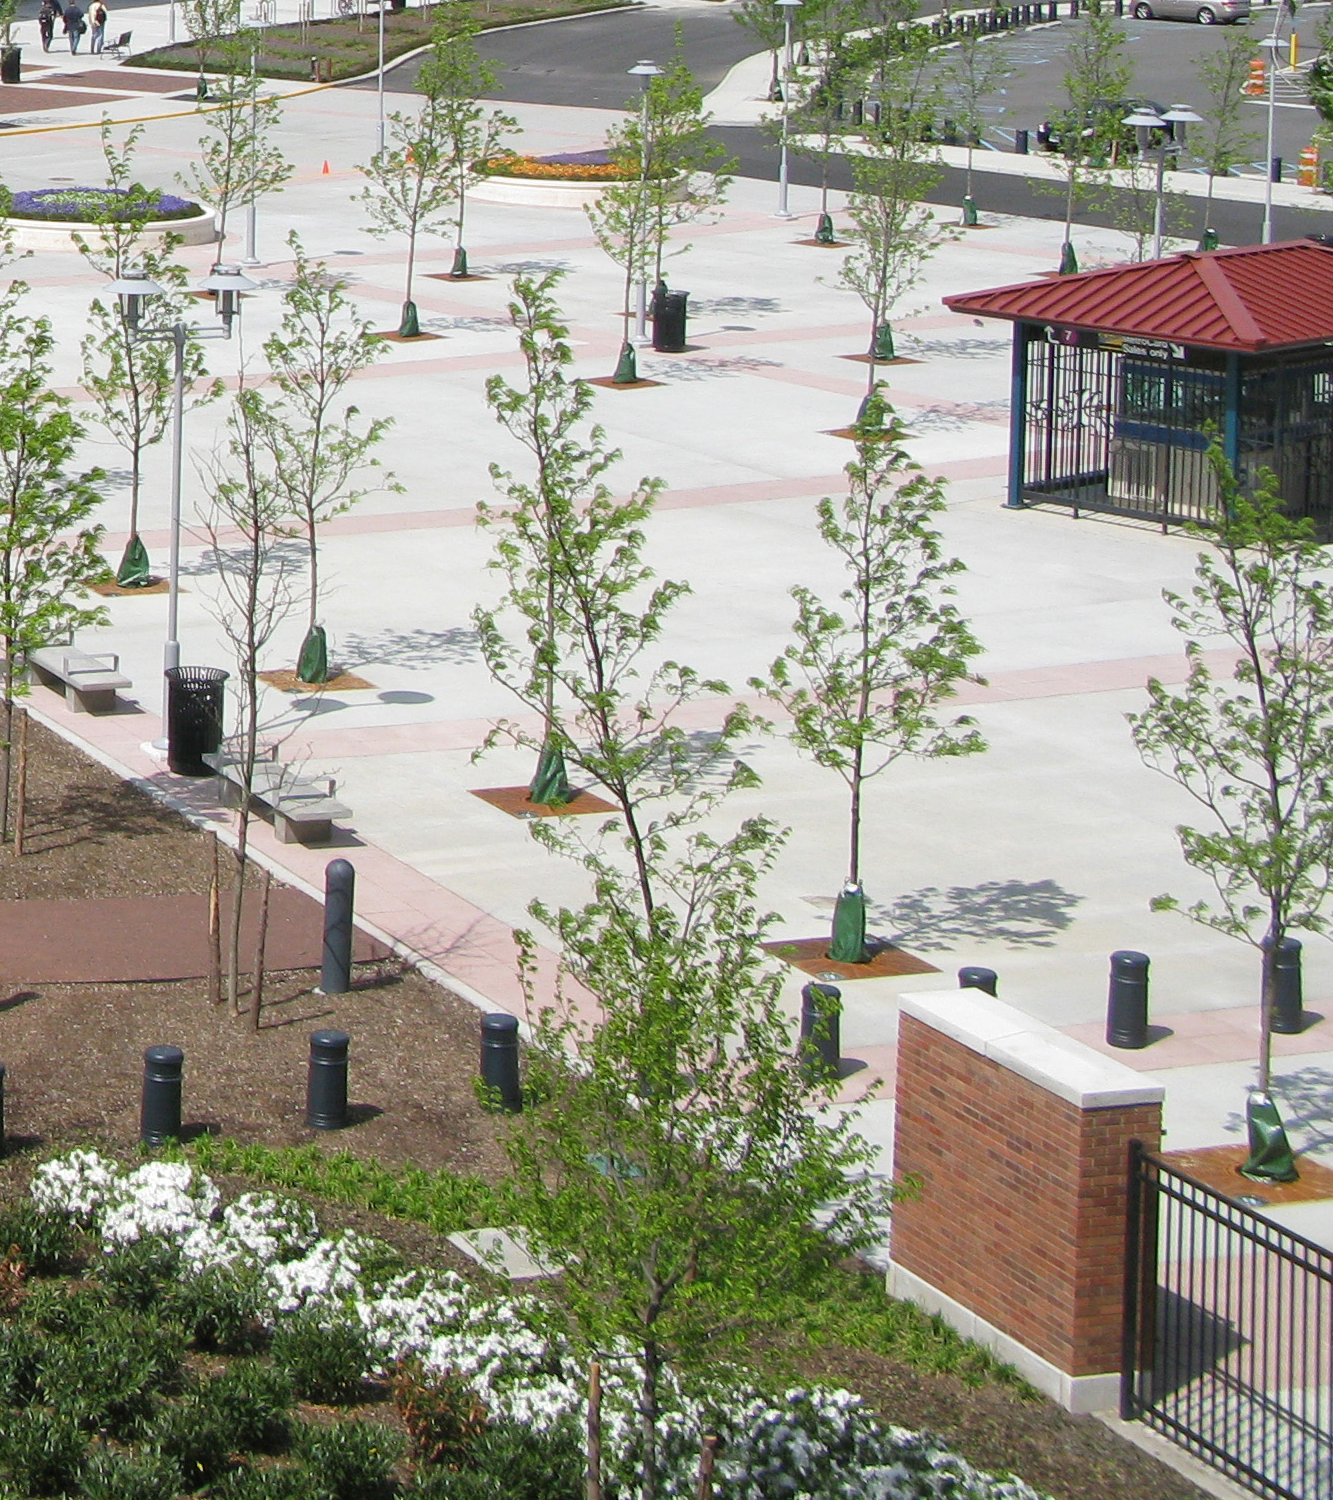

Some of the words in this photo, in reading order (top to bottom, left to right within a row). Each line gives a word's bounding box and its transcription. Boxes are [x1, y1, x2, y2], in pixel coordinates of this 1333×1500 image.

[1064, 330, 1072, 341] 7
[1122, 343, 1147, 356] Sales
[1149, 349, 1169, 360] only
